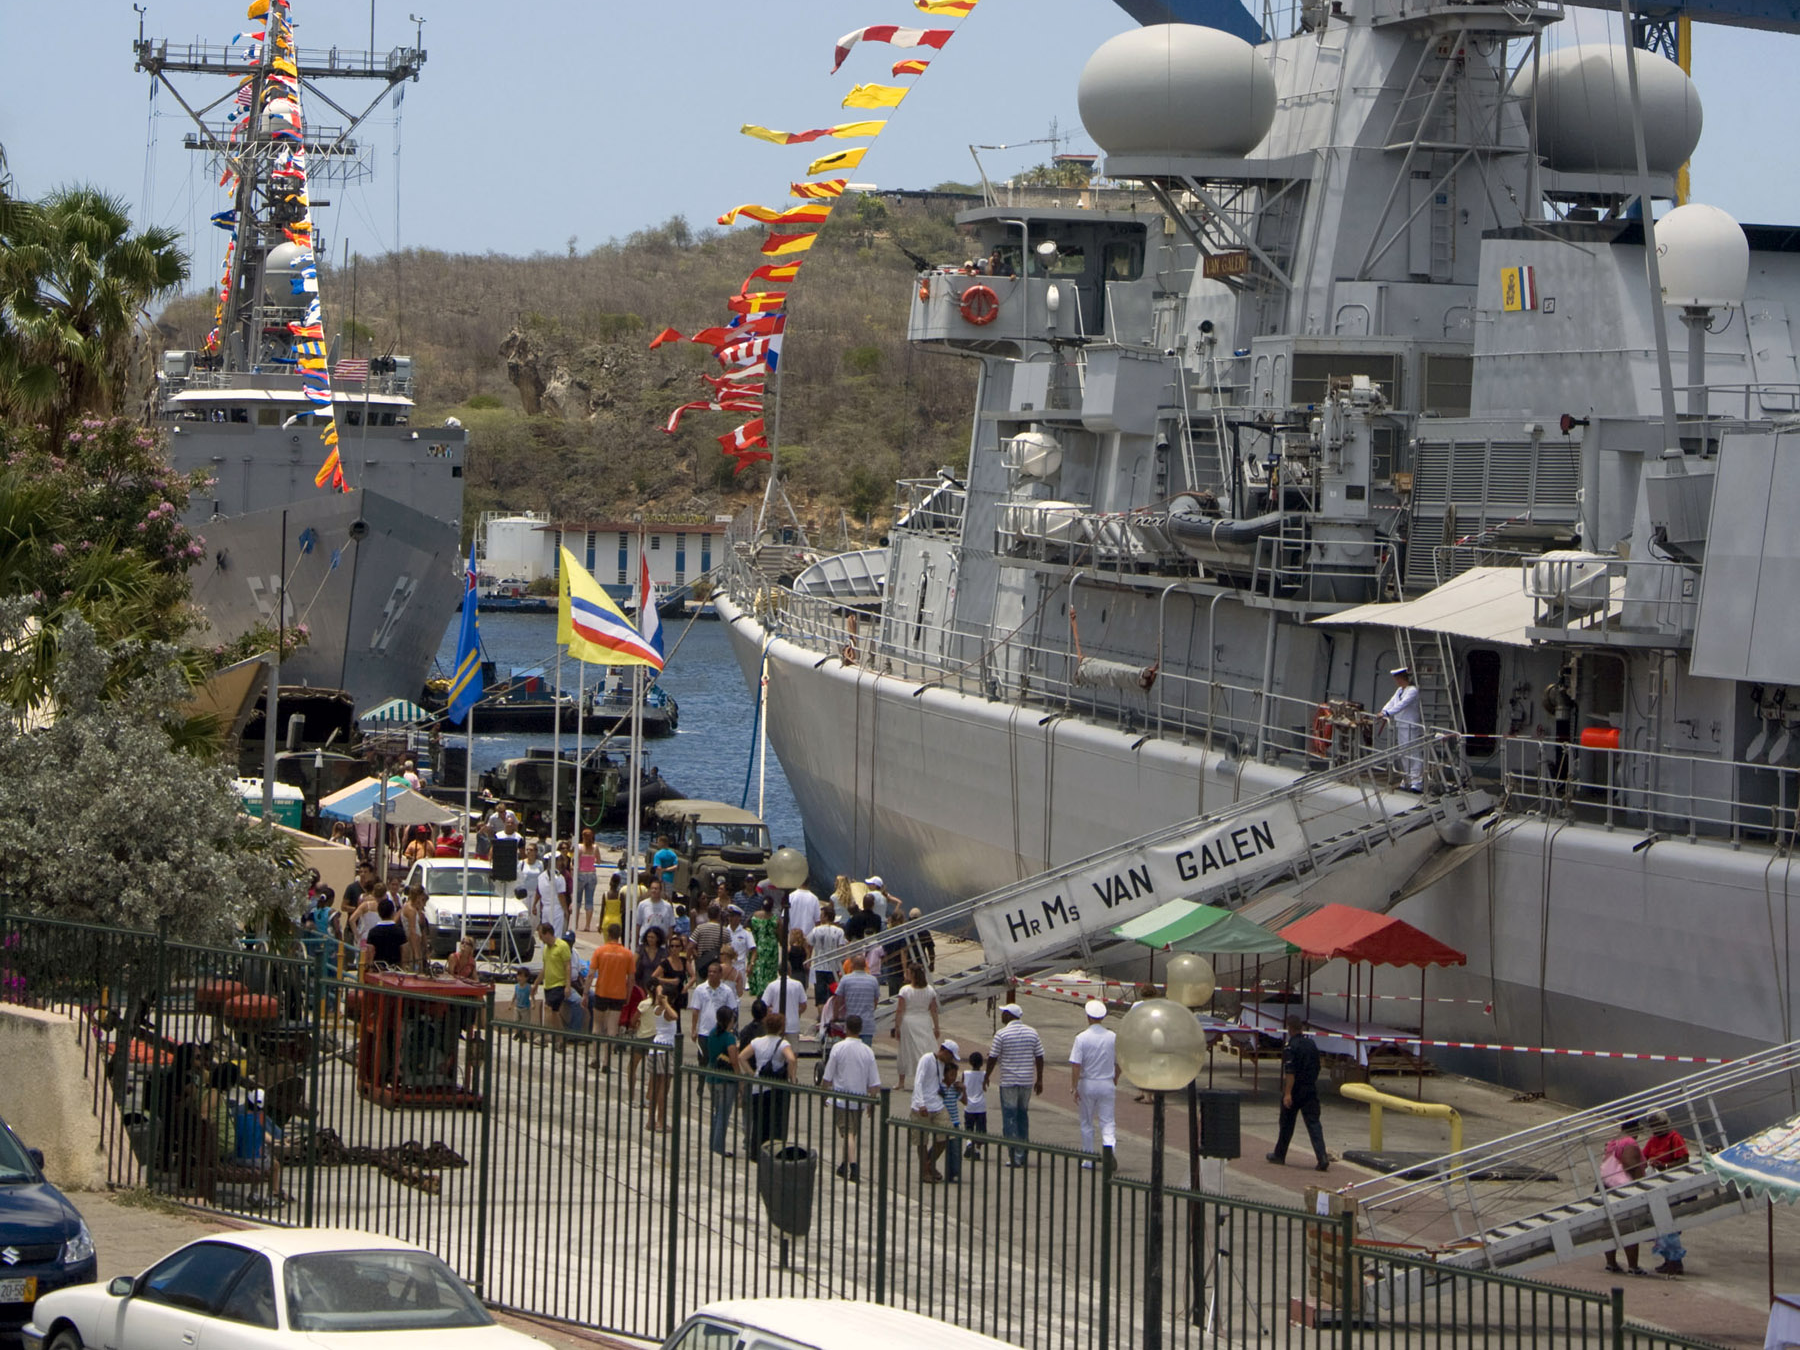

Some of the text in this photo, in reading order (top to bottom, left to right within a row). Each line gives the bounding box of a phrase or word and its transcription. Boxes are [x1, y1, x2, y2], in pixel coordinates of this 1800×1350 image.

[1205, 254, 1245, 275] VAN GALEN
[1092, 864, 1154, 909] VAN
[1175, 820, 1275, 882] GALEN
